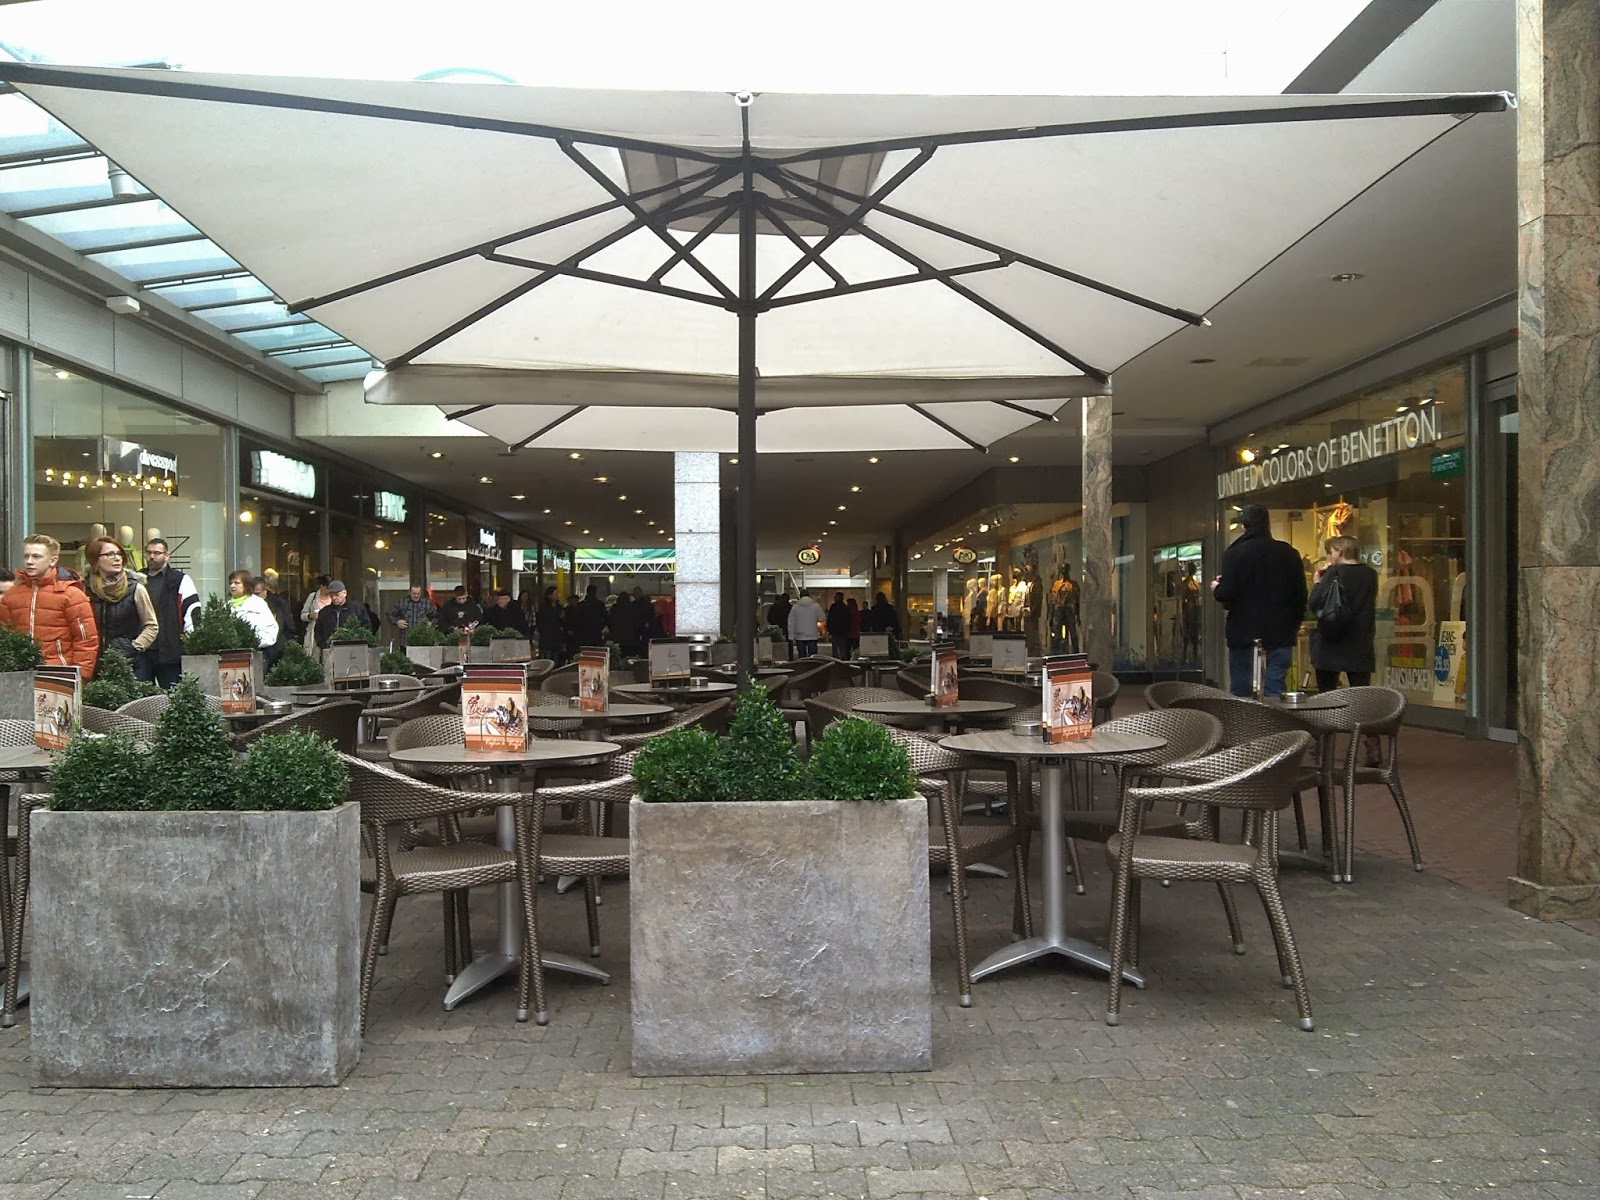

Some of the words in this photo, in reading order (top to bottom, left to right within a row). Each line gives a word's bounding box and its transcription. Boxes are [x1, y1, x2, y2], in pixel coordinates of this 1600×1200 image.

[1217, 466, 1258, 500] UNITED
[1261, 446, 1314, 487] COLORS
[1317, 438, 1337, 473] OF
[1341, 405, 1442, 466] BENETTON.
